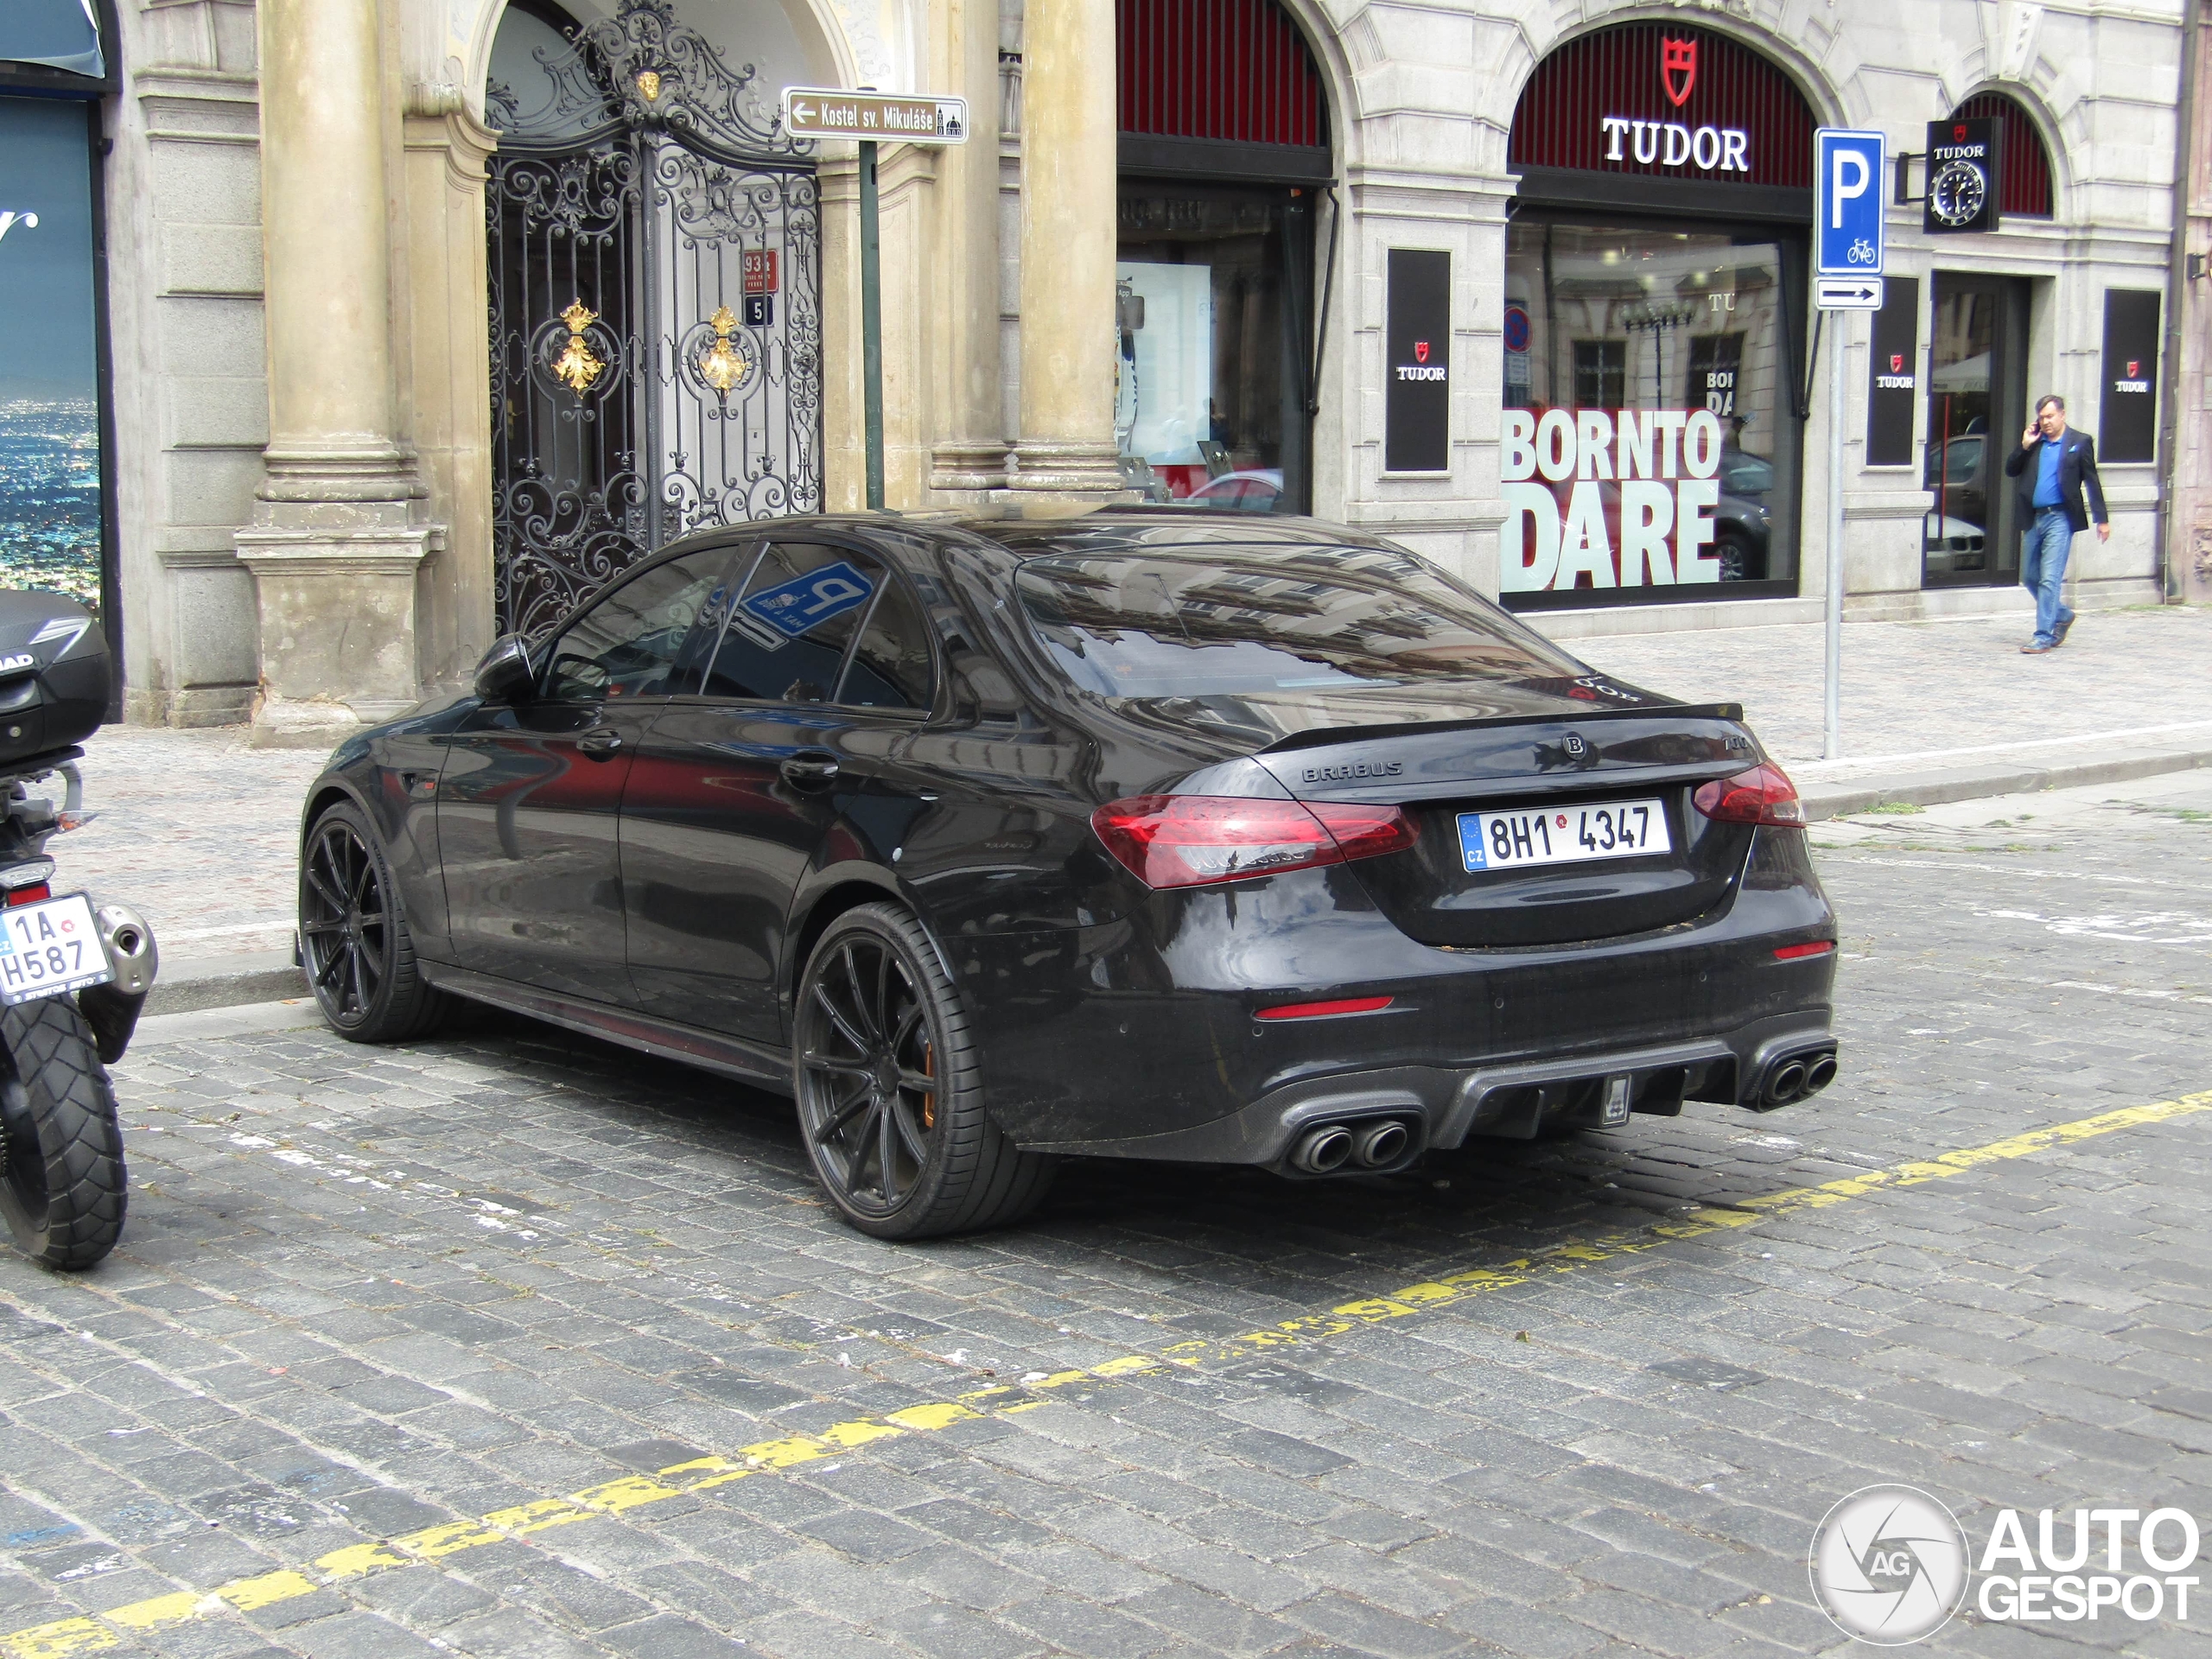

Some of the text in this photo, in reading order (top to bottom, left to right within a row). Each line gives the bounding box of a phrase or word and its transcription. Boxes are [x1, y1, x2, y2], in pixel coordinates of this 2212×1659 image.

[822, 103, 933, 130] Kostel sv. Mikuláše
[1601, 118, 1749, 172] TUDOR
[1933, 145, 1985, 160] TUDOR
[1832, 149, 1870, 229] P
[754, 302, 762, 320] 5
[1397, 365, 1446, 382] TUDOR
[1876, 376, 1914, 389] TUDOR
[2114, 381, 2148, 393] TUDOR
[1500, 480, 1719, 593] DARE
[0, 653, 35, 671] AD
[1566, 736, 1584, 754] B
[1302, 761, 1403, 783] BRABUS
[1491, 806, 1649, 861] 8H1 4347
[1467, 849, 1484, 863] CZ
[15, 911, 57, 944] 1A
[1, 939, 83, 986] H587
